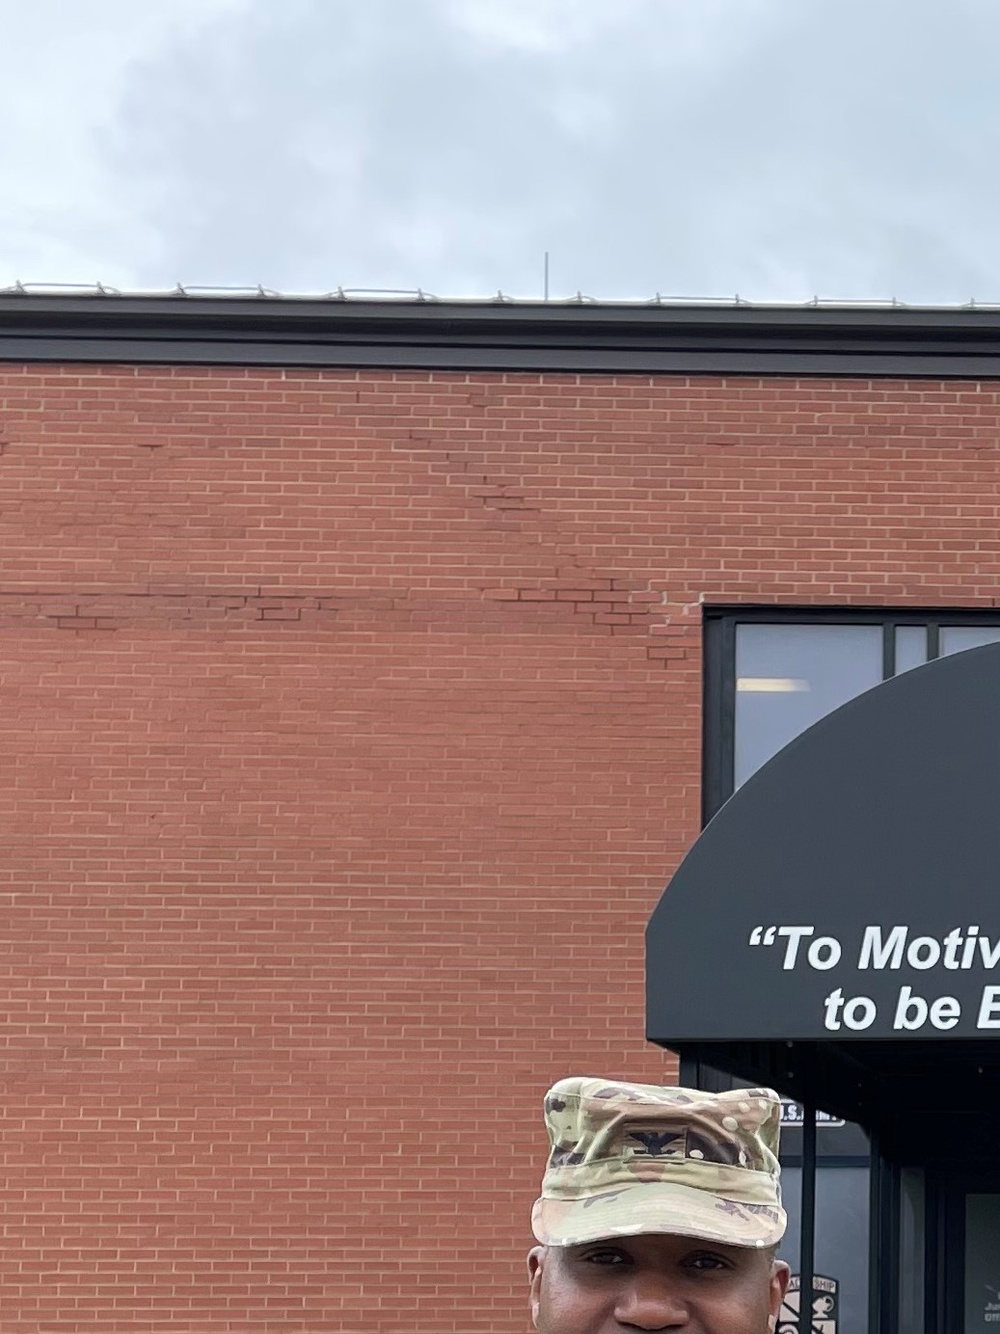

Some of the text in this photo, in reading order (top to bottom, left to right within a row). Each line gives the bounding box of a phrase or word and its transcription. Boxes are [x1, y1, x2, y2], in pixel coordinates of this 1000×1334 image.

[749, 926, 843, 971] “To
[823, 987, 878, 1031] to
[892, 985, 962, 1031] be
